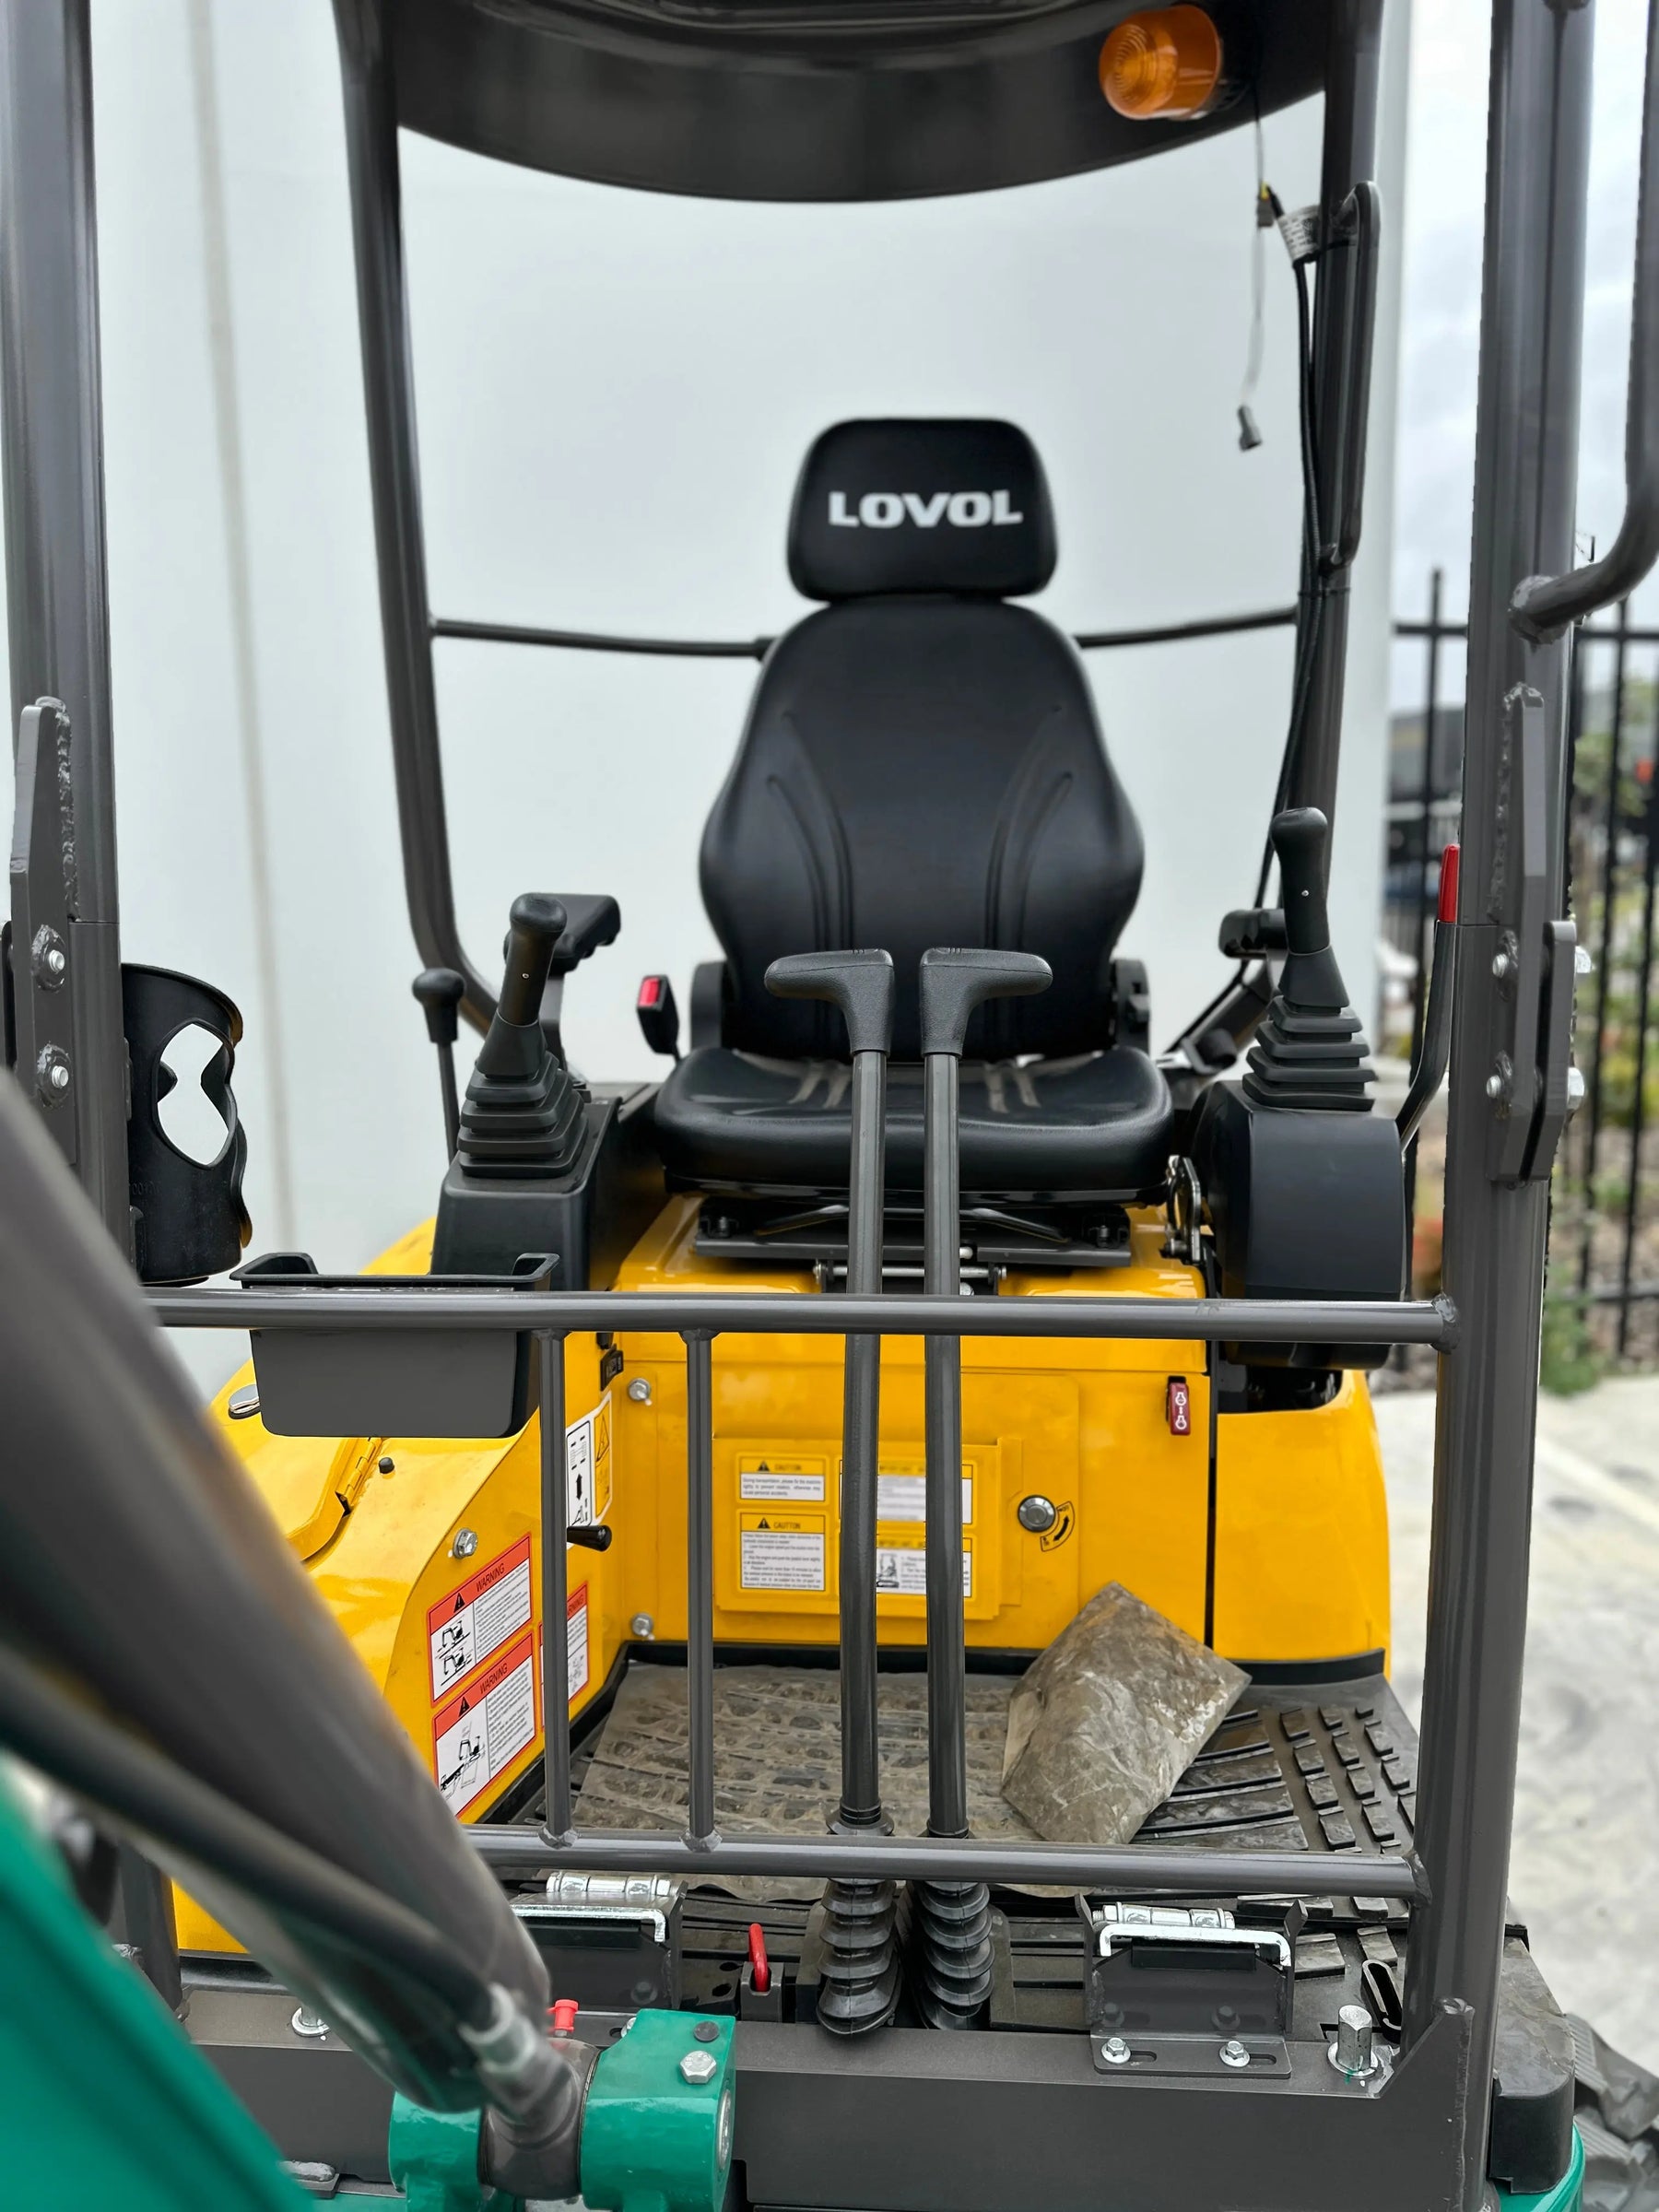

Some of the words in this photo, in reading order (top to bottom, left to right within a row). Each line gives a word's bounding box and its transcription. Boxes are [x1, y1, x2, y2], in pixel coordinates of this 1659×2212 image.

[829, 489, 1024, 528] LOVOL
[476, 1562, 506, 1593] WARNING
[480, 1662, 508, 1694] WARNING
